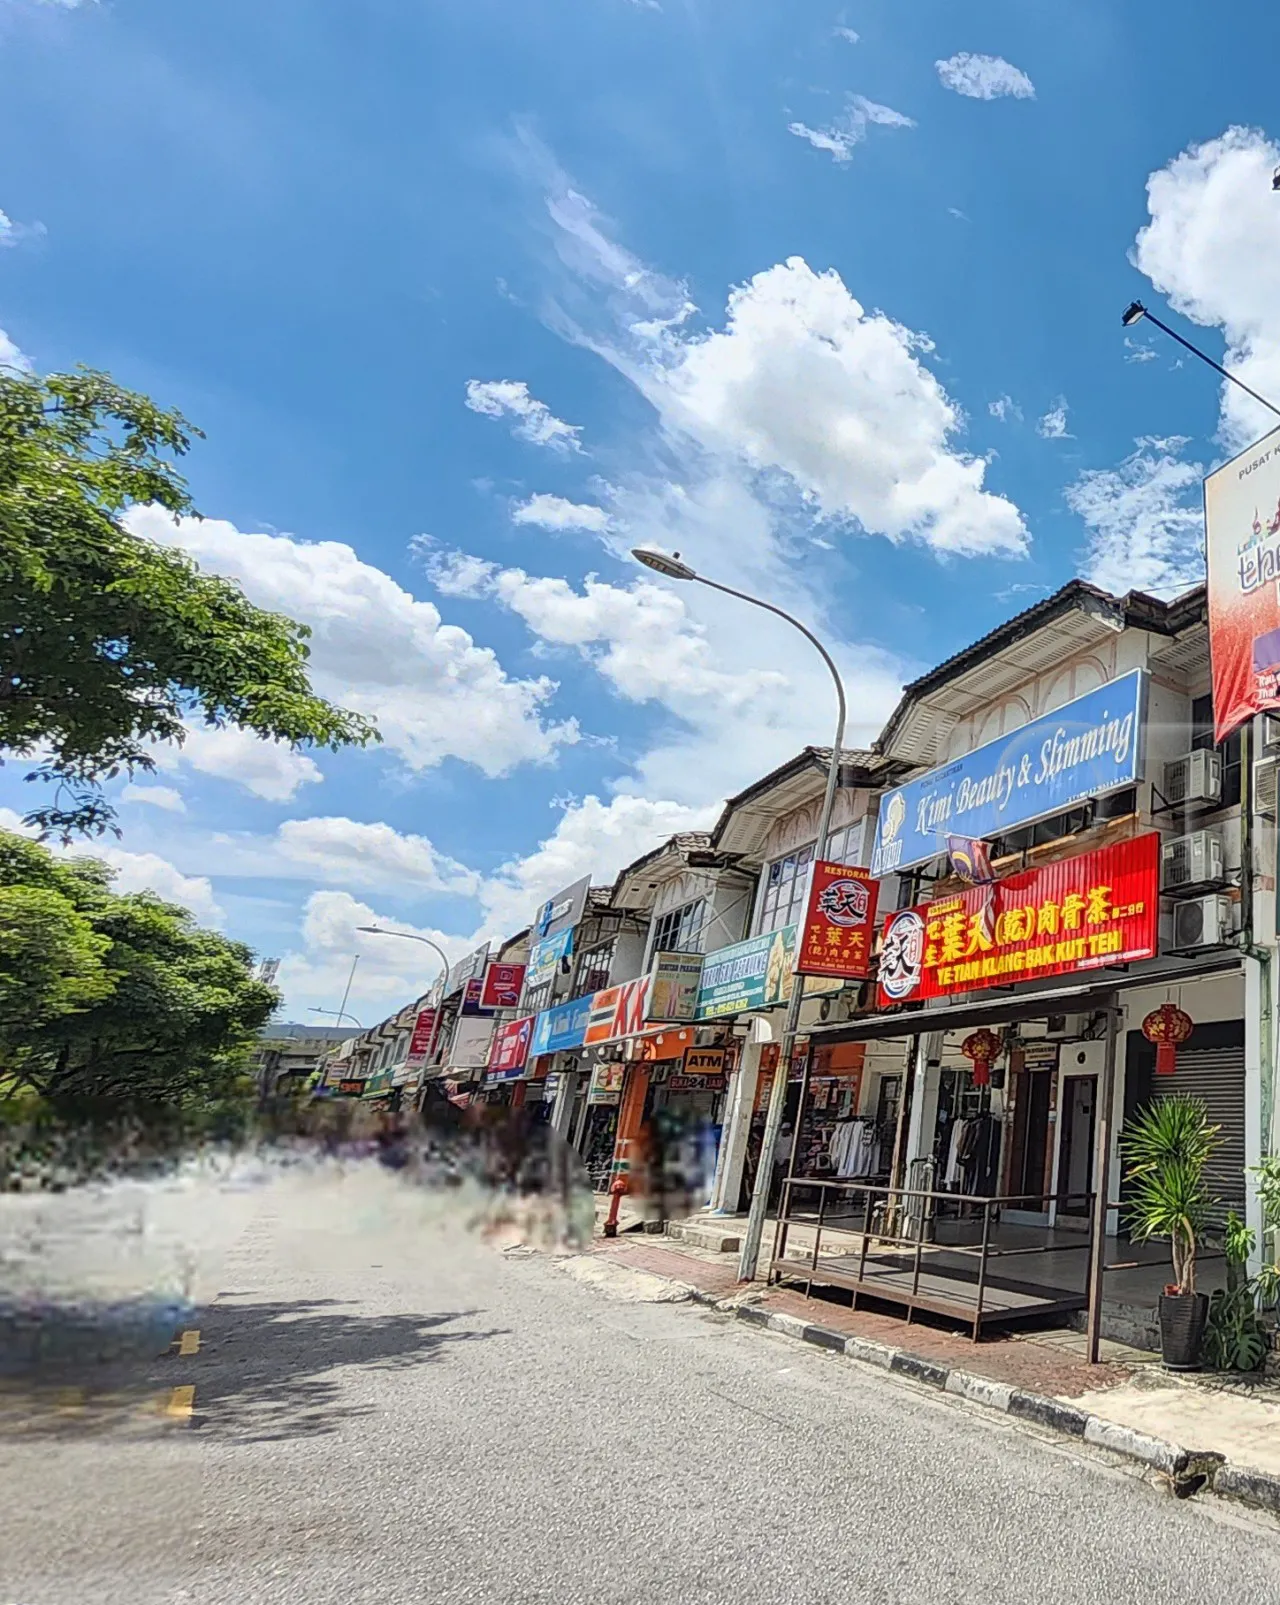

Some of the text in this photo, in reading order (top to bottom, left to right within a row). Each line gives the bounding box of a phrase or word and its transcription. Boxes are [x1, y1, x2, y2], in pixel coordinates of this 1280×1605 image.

[1238, 451, 1272, 480] PUSAT
[915, 781, 955, 835] Kimi
[956, 763, 1016, 815] Beauty
[1017, 753, 1032, 788] &
[1034, 709, 1134, 785] Slimming
[937, 966, 954, 986] YE
[954, 960, 979, 982] TIAN
[981, 951, 1026, 977] KLANG
[1025, 944, 1054, 970] BAK
[1055, 937, 1086, 962] KUT
[1088, 930, 1121, 955] TEH
[688, 1055, 722, 1067] ATM
